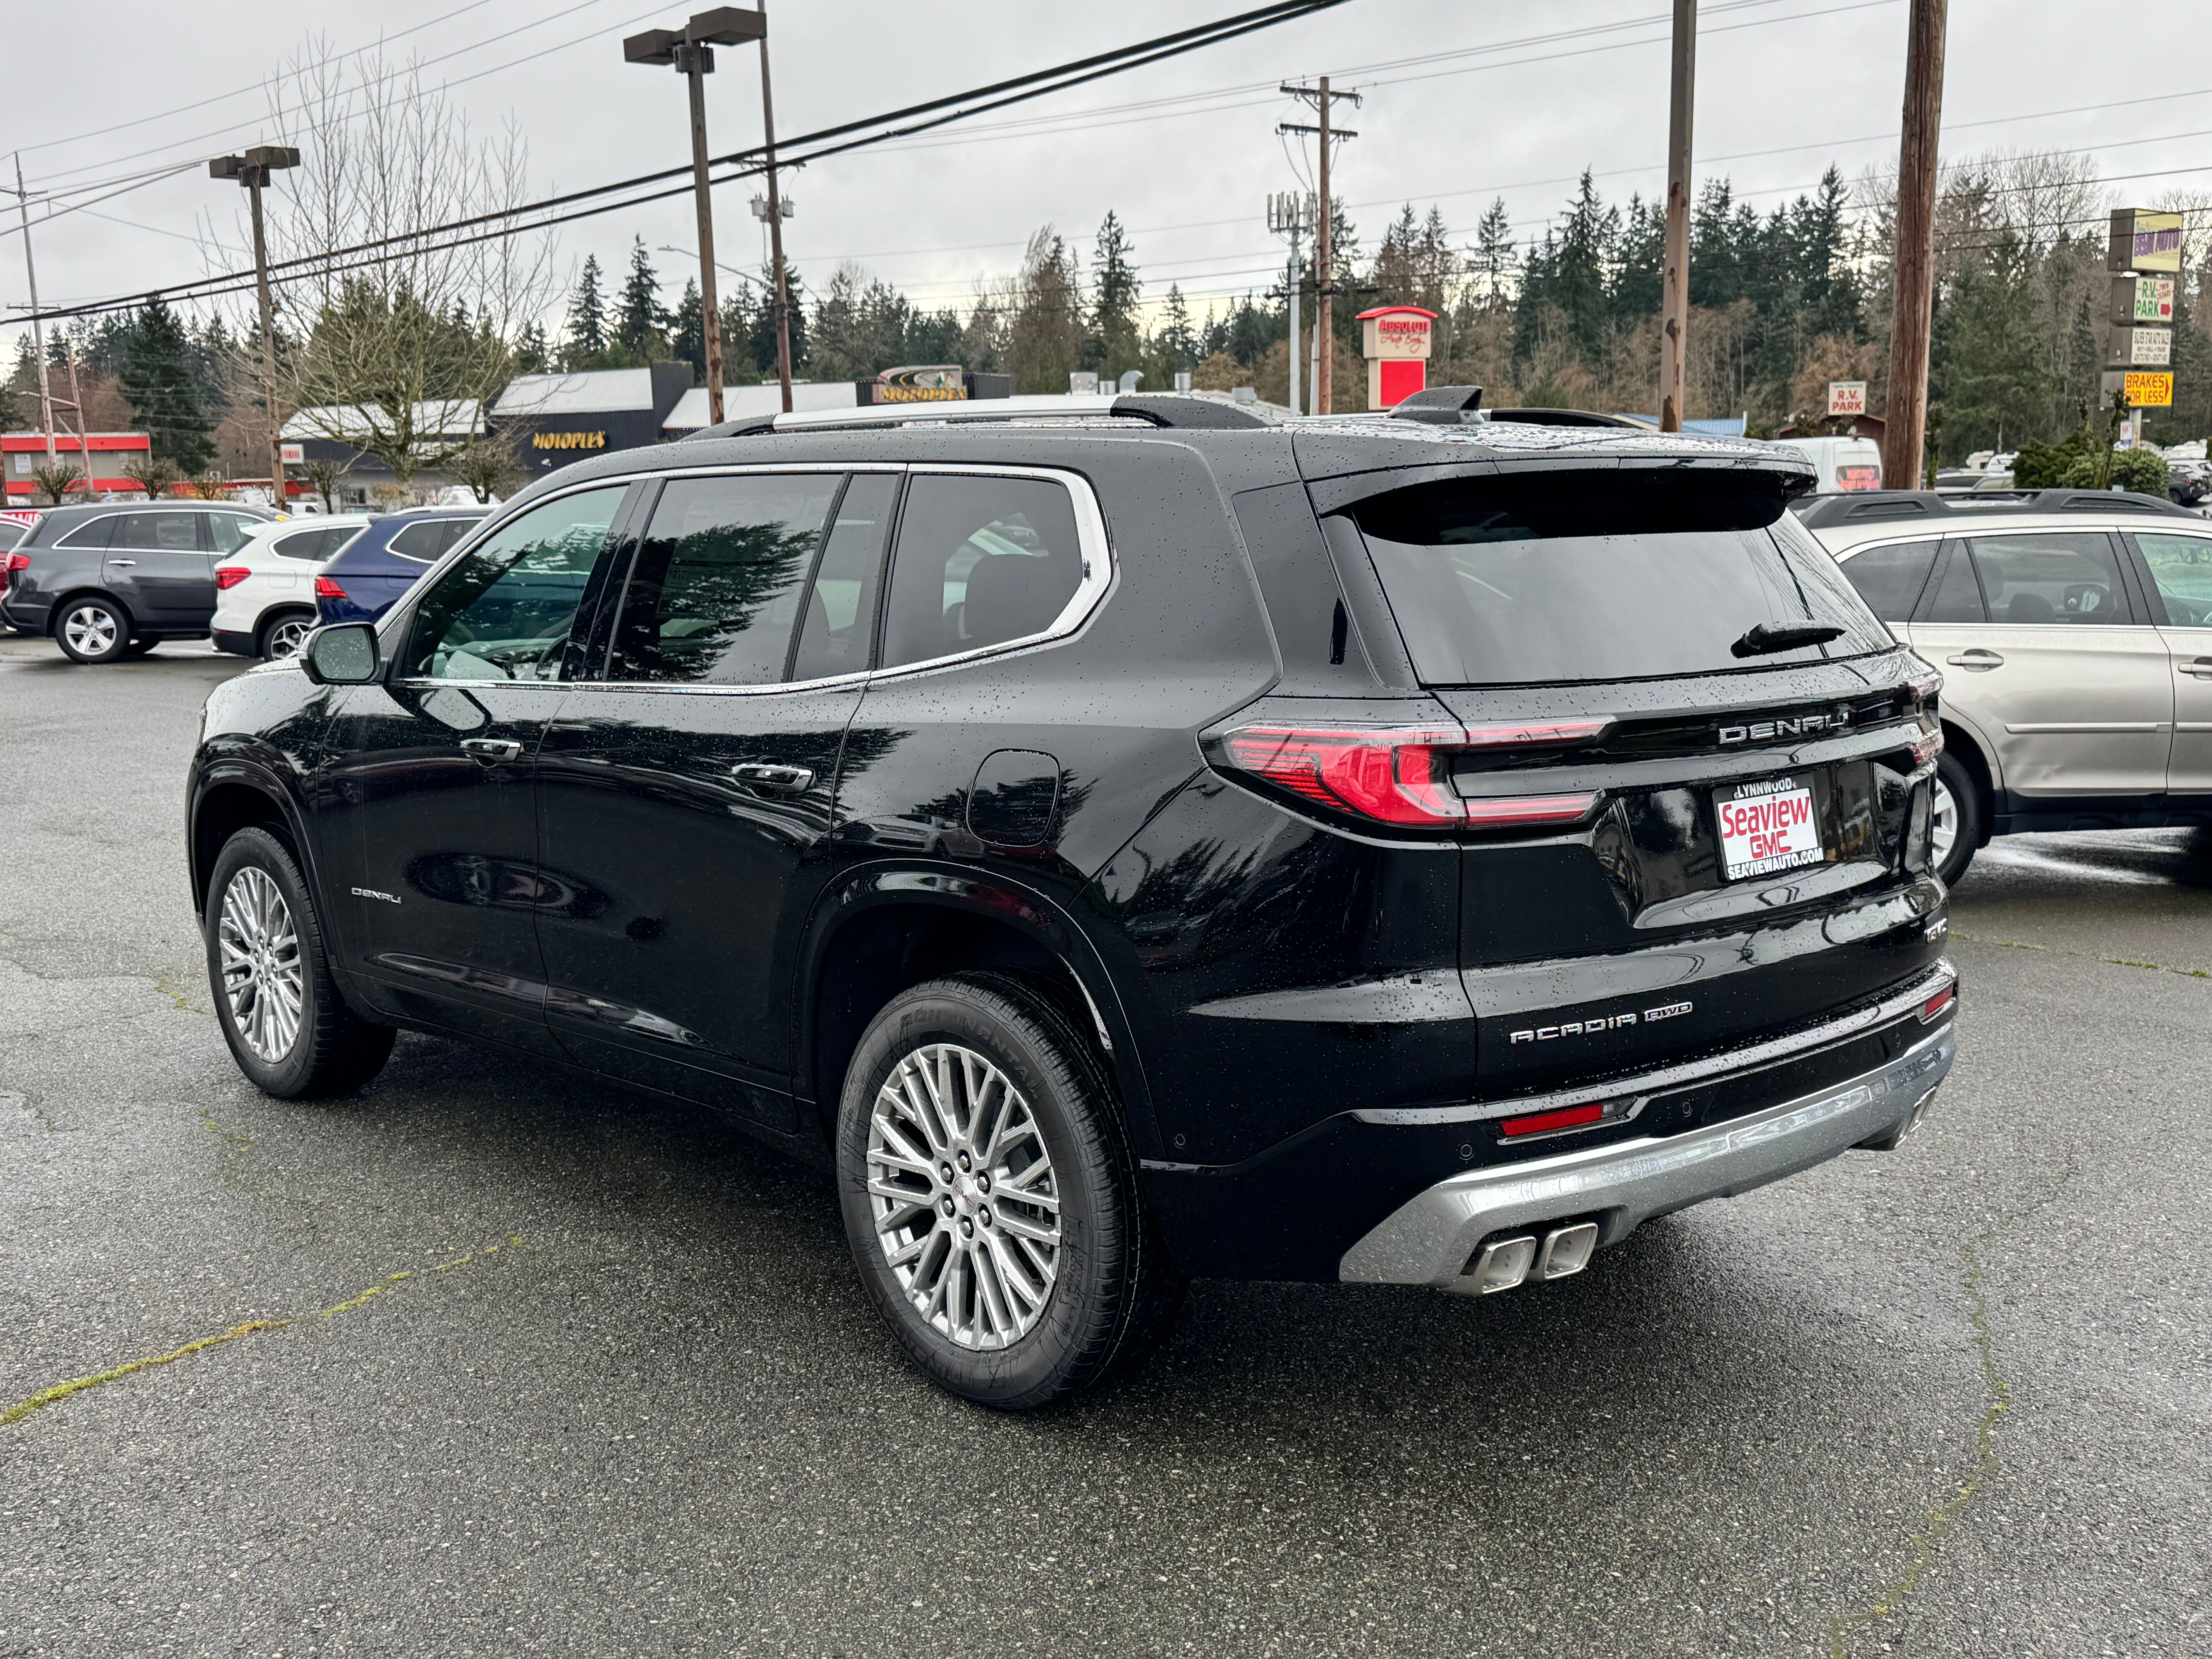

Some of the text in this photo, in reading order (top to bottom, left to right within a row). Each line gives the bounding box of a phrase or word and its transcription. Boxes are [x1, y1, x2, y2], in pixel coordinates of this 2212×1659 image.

[2142, 281, 2156, 298] R.V.
[2136, 300, 2159, 317] PARK
[2126, 374, 2164, 388] BRAKES
[1838, 390, 1858, 400] R.V.
[2144, 390, 2164, 403] LESS
[1832, 401, 1862, 412] PARK
[532, 431, 605, 450] MOTOPLEX
[283, 450, 300, 459] YAMAHA
[1719, 711, 1849, 744] DENALI
[1737, 777, 1792, 799] LYNNWOOD
[1722, 795, 1810, 839] Seaview
[1750, 830, 1791, 859] GMC
[1728, 847, 1824, 880] SEAVIEWAUTO.COM
[351, 887, 402, 904] DENALI
[1510, 1001, 1693, 1044] ACADIA AWD
[955, 1184, 974, 1207] GMC
